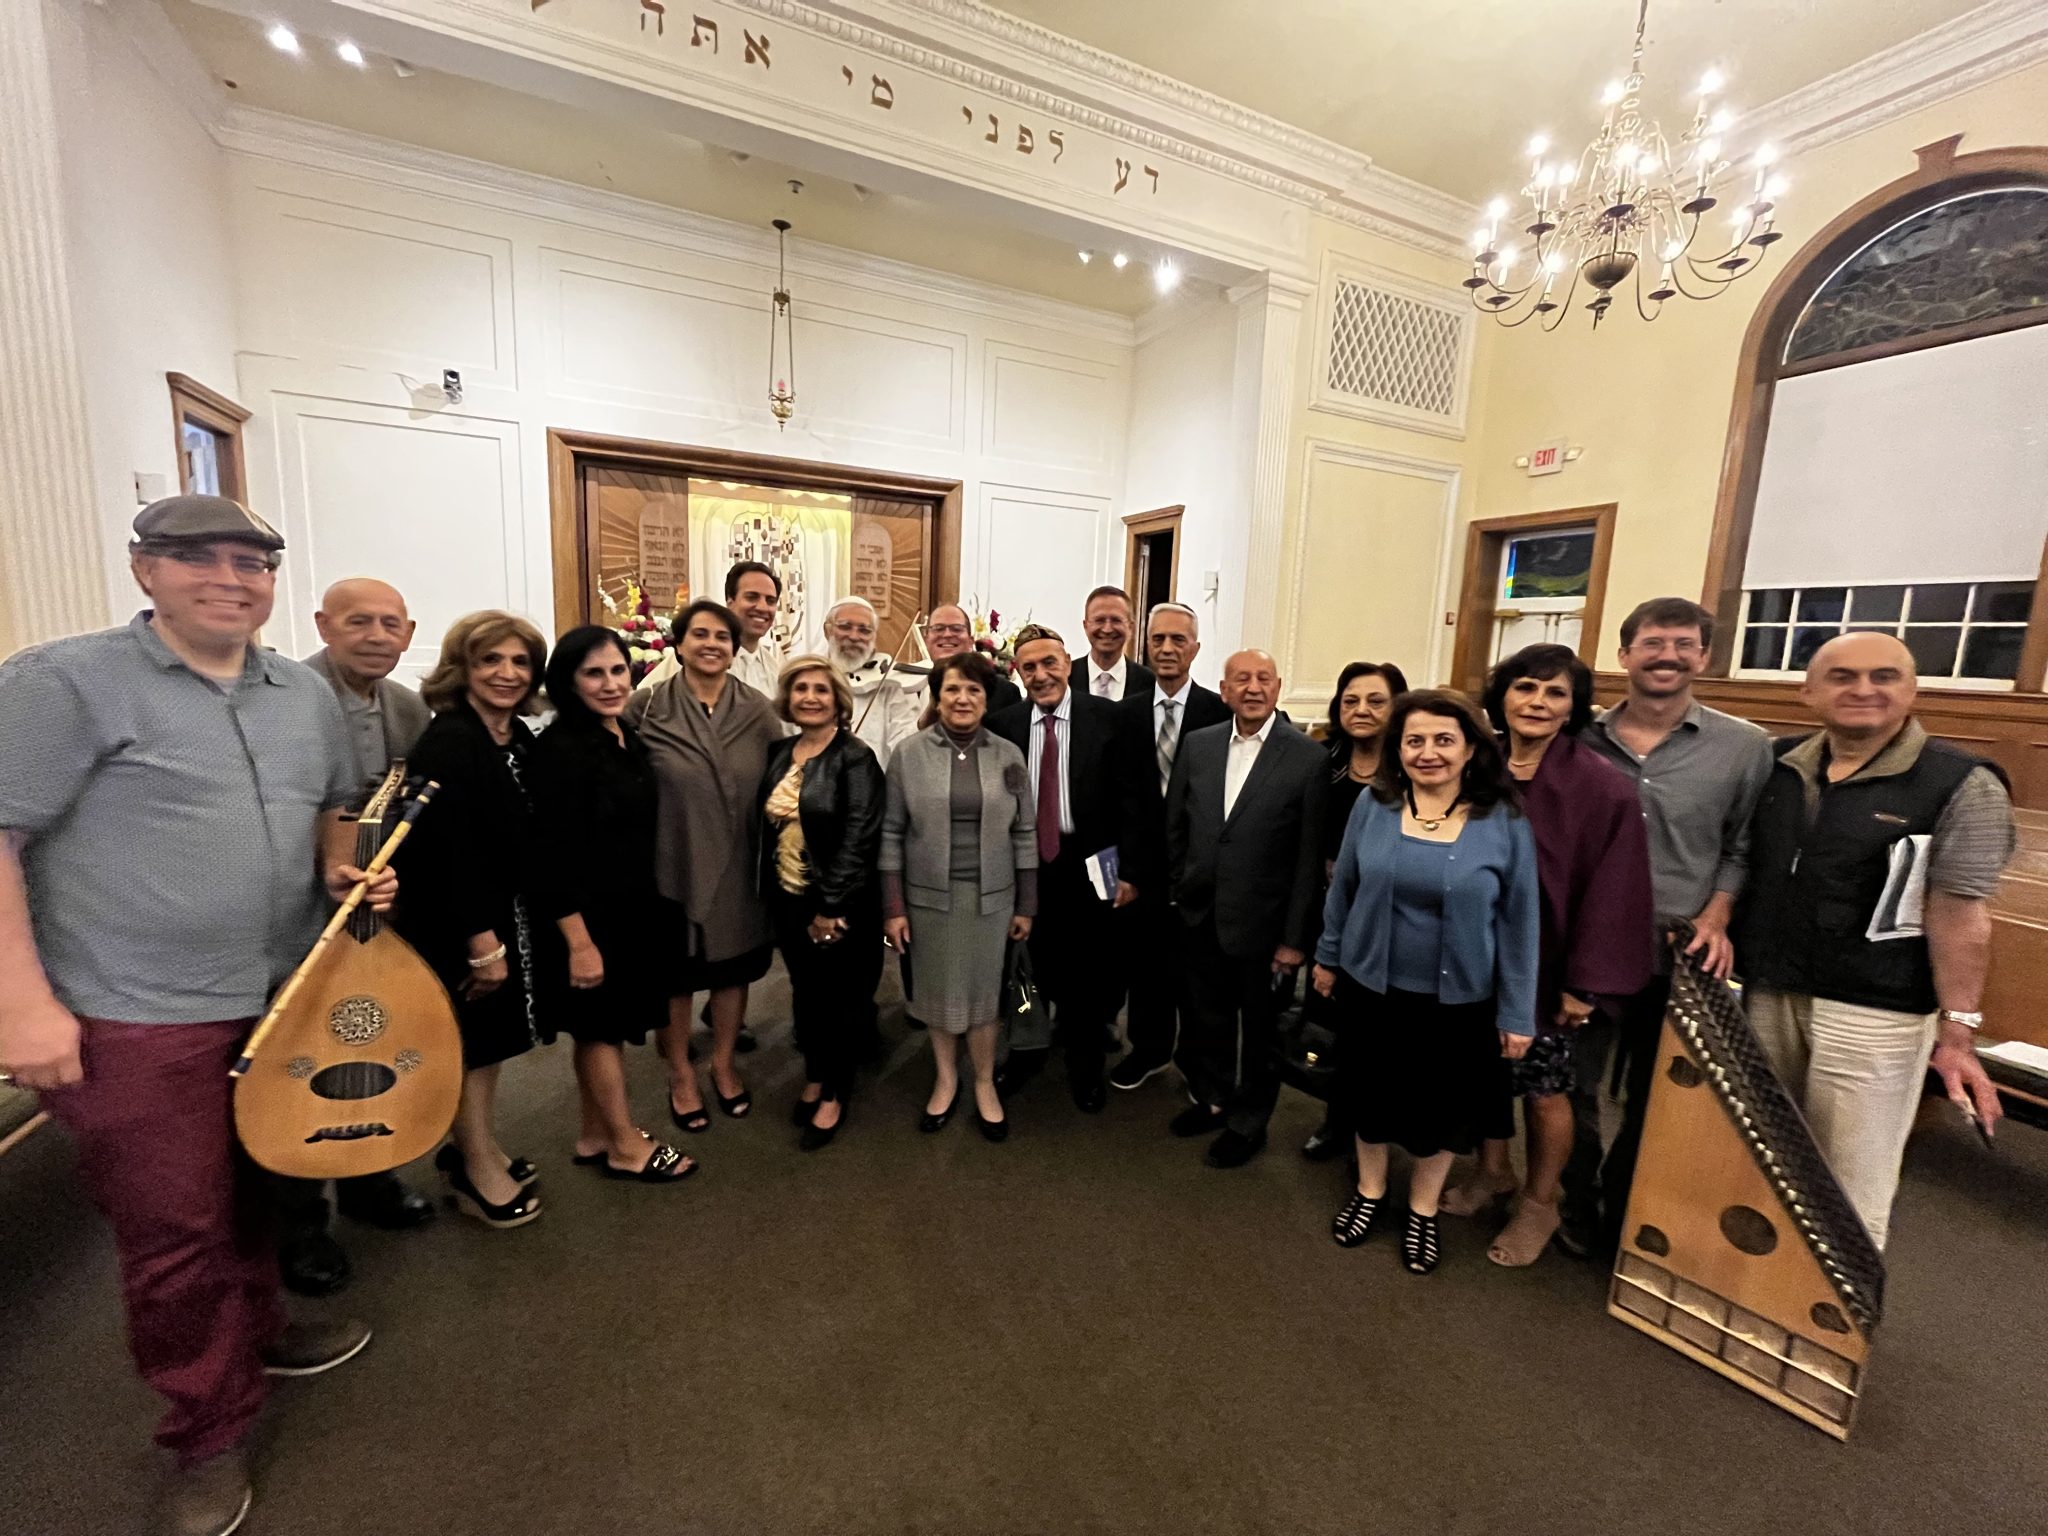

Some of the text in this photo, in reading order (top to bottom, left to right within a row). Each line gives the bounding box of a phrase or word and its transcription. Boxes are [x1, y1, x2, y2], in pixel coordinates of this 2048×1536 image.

[842, 65, 895, 110] מי
[962, 105, 1064, 164] לפני
[1113, 157, 1160, 195] דע
[1535, 447, 1557, 467] EXIT
